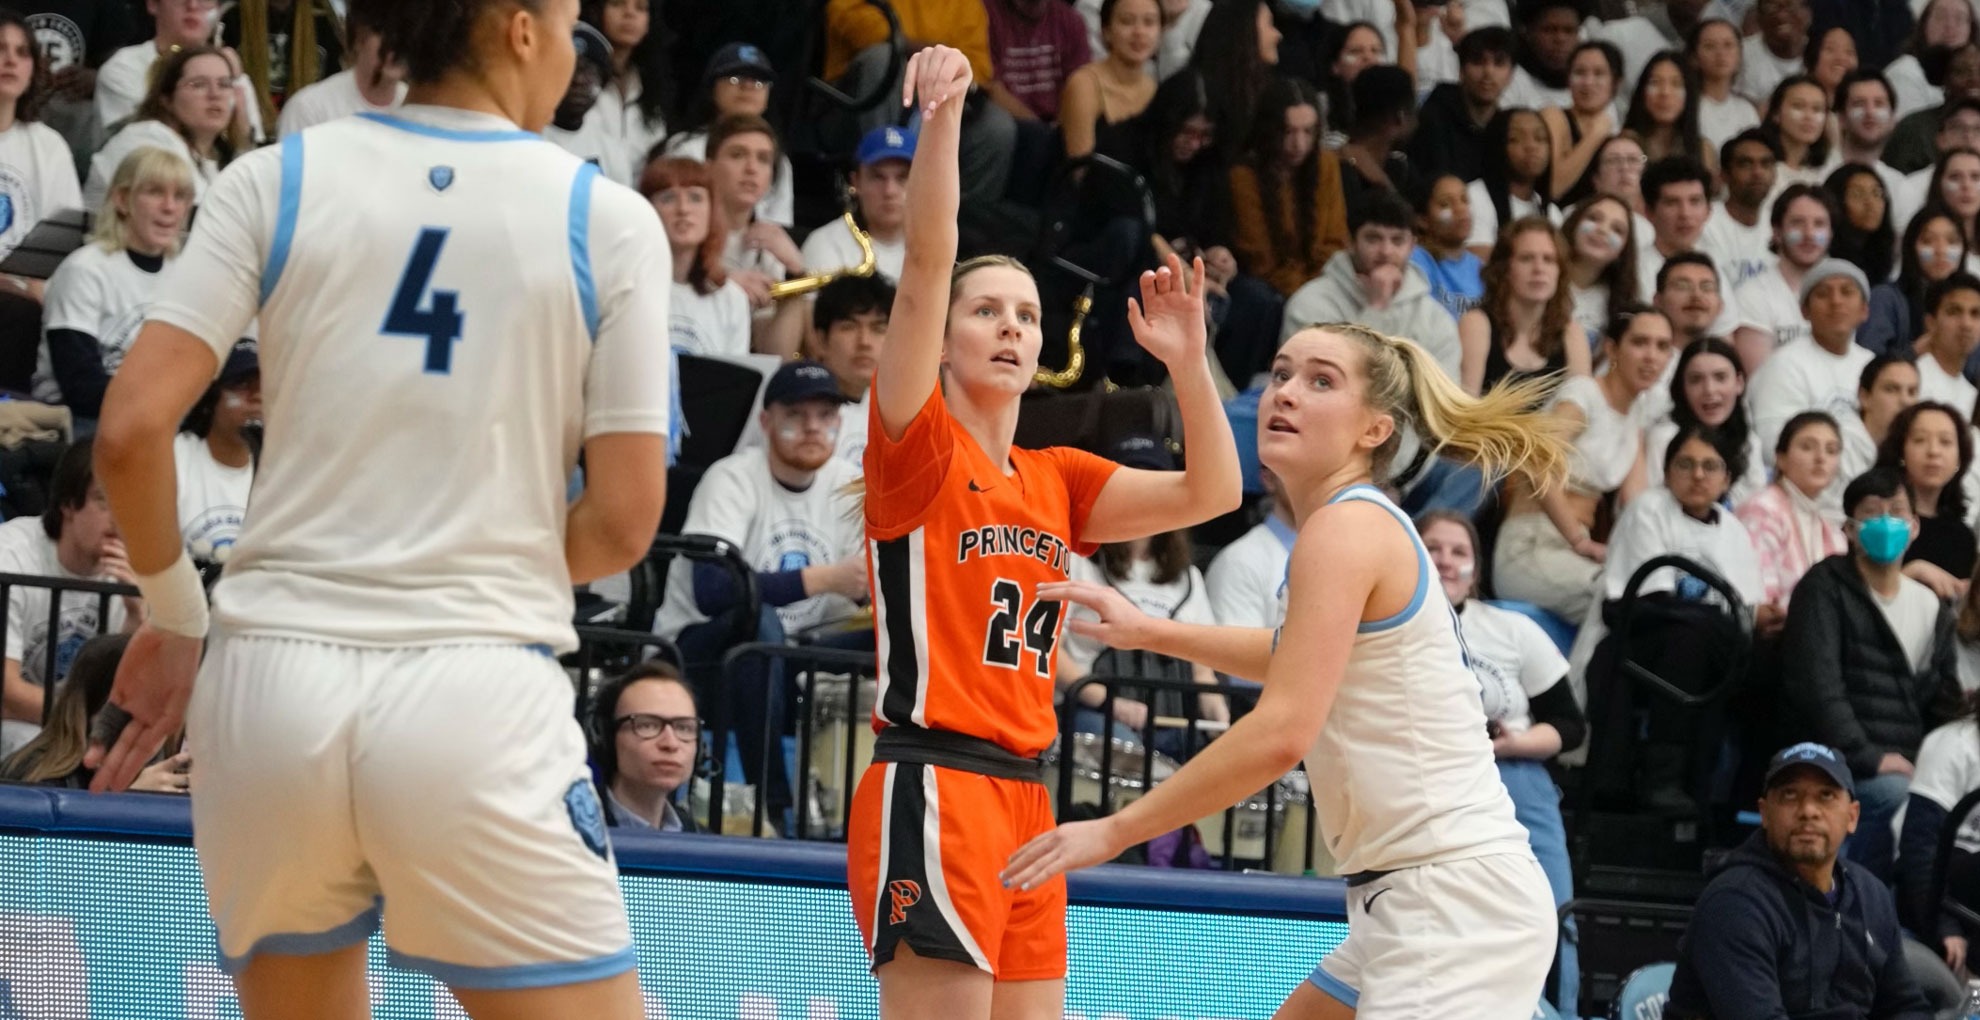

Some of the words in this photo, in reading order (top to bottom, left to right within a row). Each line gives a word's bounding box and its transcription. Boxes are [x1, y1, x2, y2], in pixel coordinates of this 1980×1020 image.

[378, 225, 466, 376] 4
[982, 577, 1061, 679] 24
[889, 879, 922, 926] P
